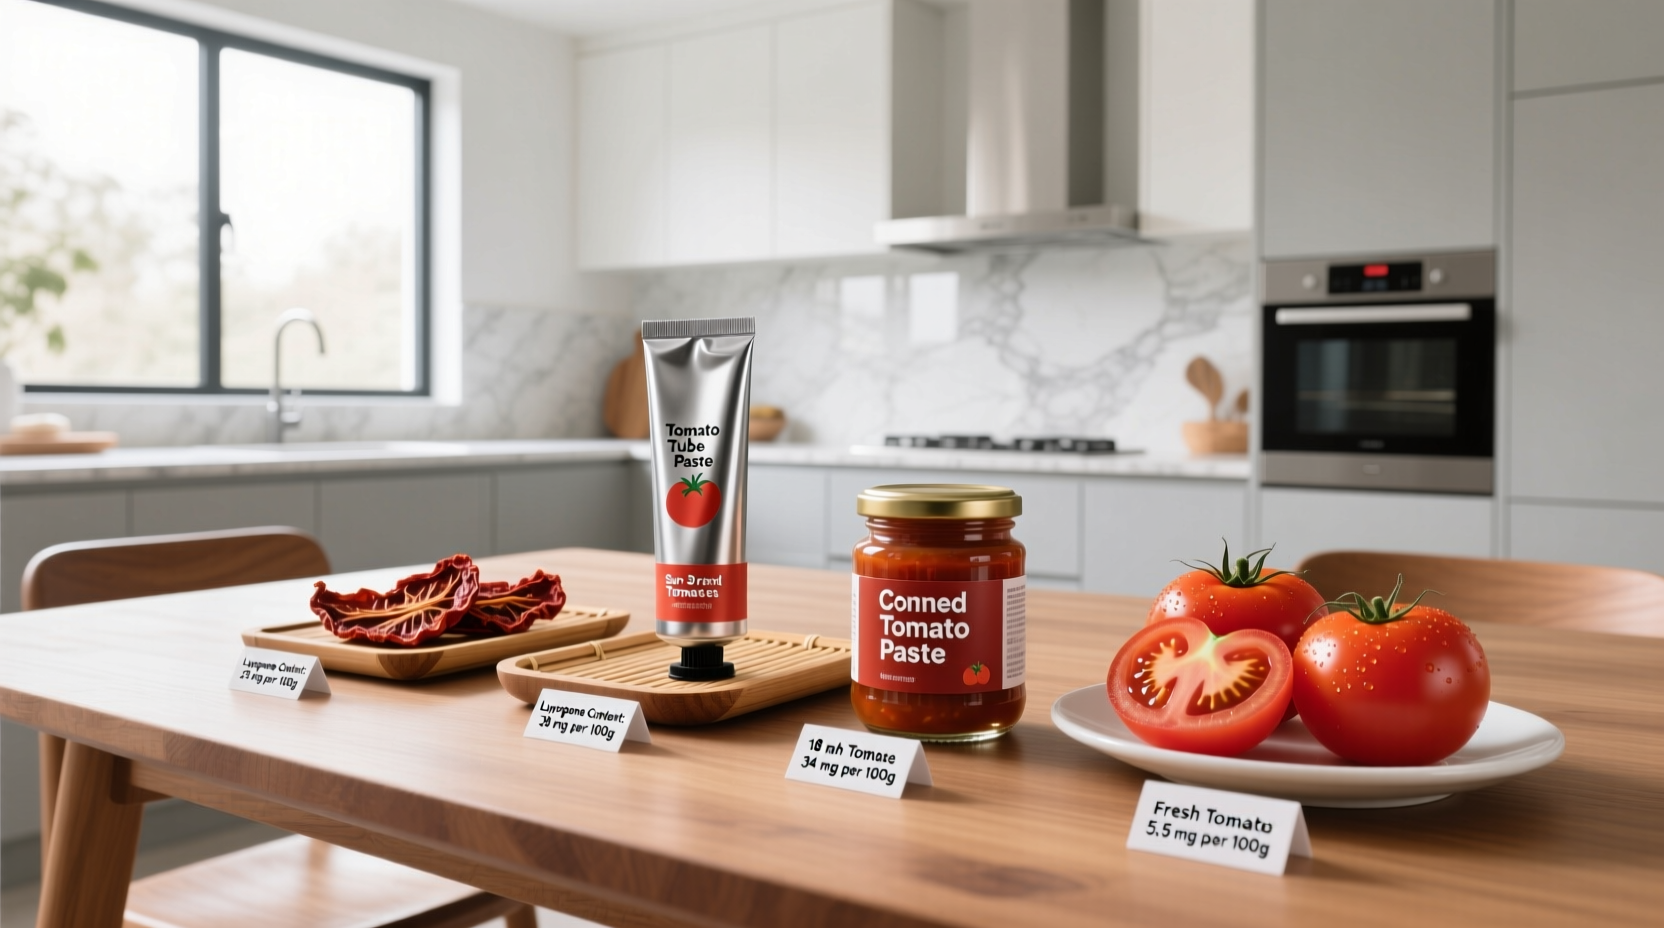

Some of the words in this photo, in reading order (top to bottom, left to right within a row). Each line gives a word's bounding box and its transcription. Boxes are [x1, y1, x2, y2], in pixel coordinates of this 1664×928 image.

[665, 423, 720, 437] Tomato
[667, 437, 705, 452] Tube
[674, 454, 714, 468] Paste
[879, 588, 967, 613] Conned
[879, 614, 970, 639] Tomato
[880, 638, 946, 664] Paste
[570, 723, 589, 734] per
[590, 723, 616, 742] 100g
[801, 755, 818, 769] 34
[820, 762, 840, 777] mg
[841, 765, 863, 778] per
[865, 766, 896, 787] 100g
[1153, 801, 1200, 822] Fresh
[1206, 808, 1273, 834] Tomato
[1174, 829, 1198, 847] mg
[1200, 833, 1229, 848] per
[1232, 835, 1271, 860] 100g
